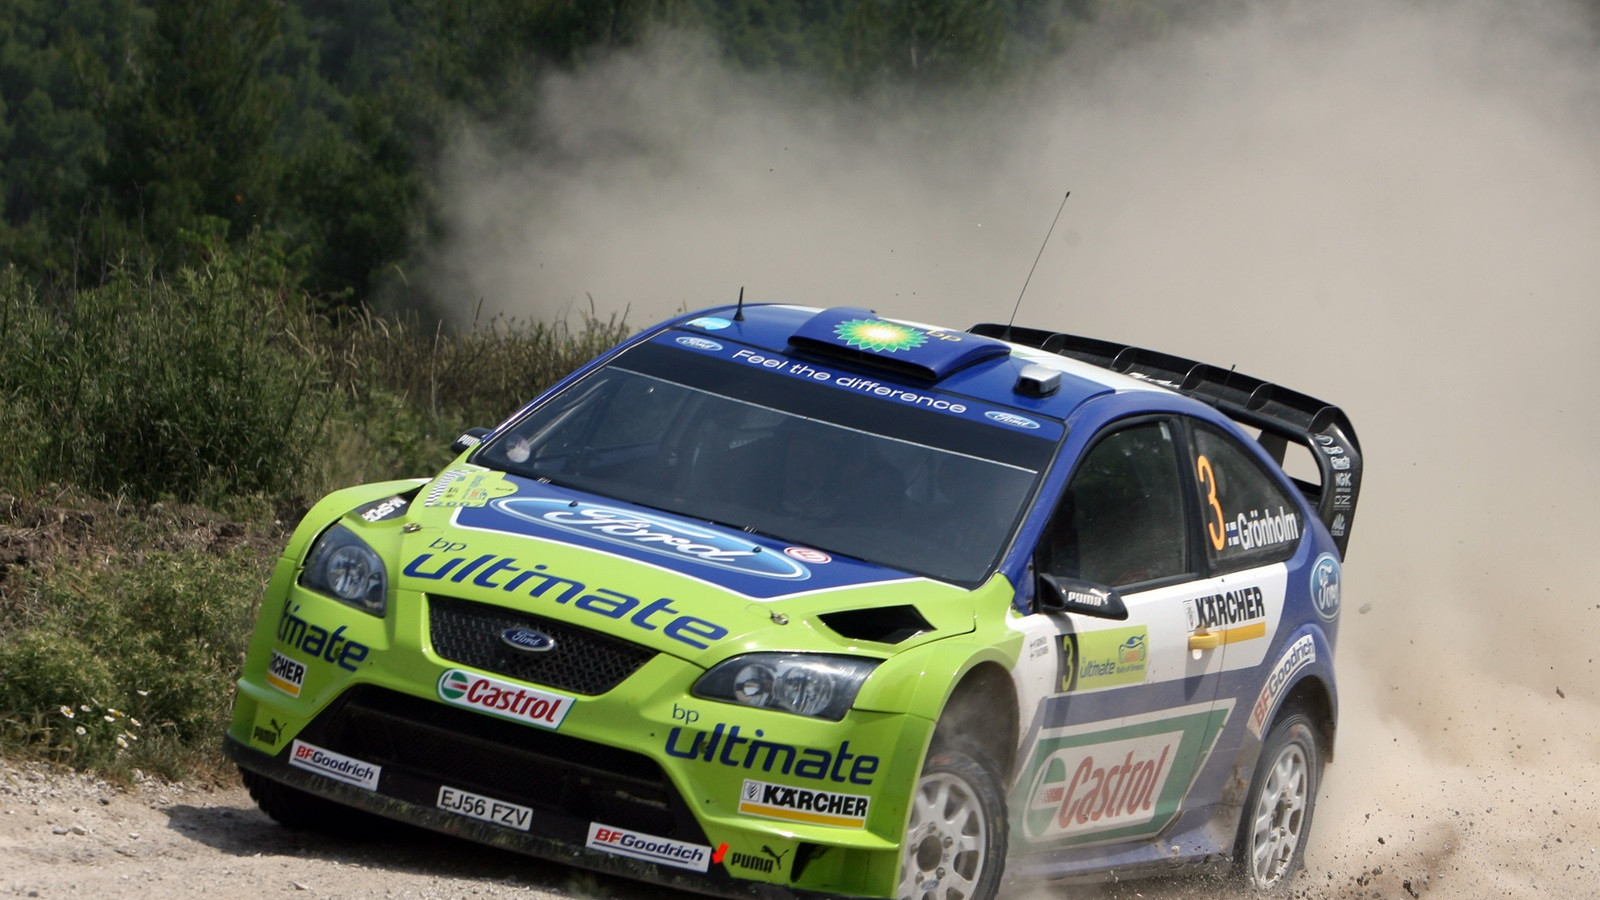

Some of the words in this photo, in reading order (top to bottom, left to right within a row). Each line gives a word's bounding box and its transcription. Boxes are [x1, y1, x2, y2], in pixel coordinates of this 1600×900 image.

[732, 349, 788, 371] Feel
[789, 363, 831, 382] the
[835, 375, 967, 414] difference
[1197, 455, 1225, 551] 3
[428, 537, 468, 553] bp
[543, 503, 742, 562] Ford
[1237, 506, 1299, 550] Grönholm
[402, 553, 730, 650] ultimate
[1195, 586, 1266, 628] KÄRCHER
[511, 630, 544, 647] Ford
[1061, 634, 1074, 692] 3
[467, 679, 563, 724] Castrol
[672, 703, 699, 725] bp
[295, 744, 374, 781] BFGoodrich
[664, 723, 880, 785] ultimate
[442, 788, 485, 817] EJ56
[491, 803, 530, 828] FZV
[762, 785, 867, 817] KÄRCHER
[1058, 744, 1171, 829] Castrol
[594, 828, 704, 861] BFGoodrich
[731, 852, 773, 873] PUMA
